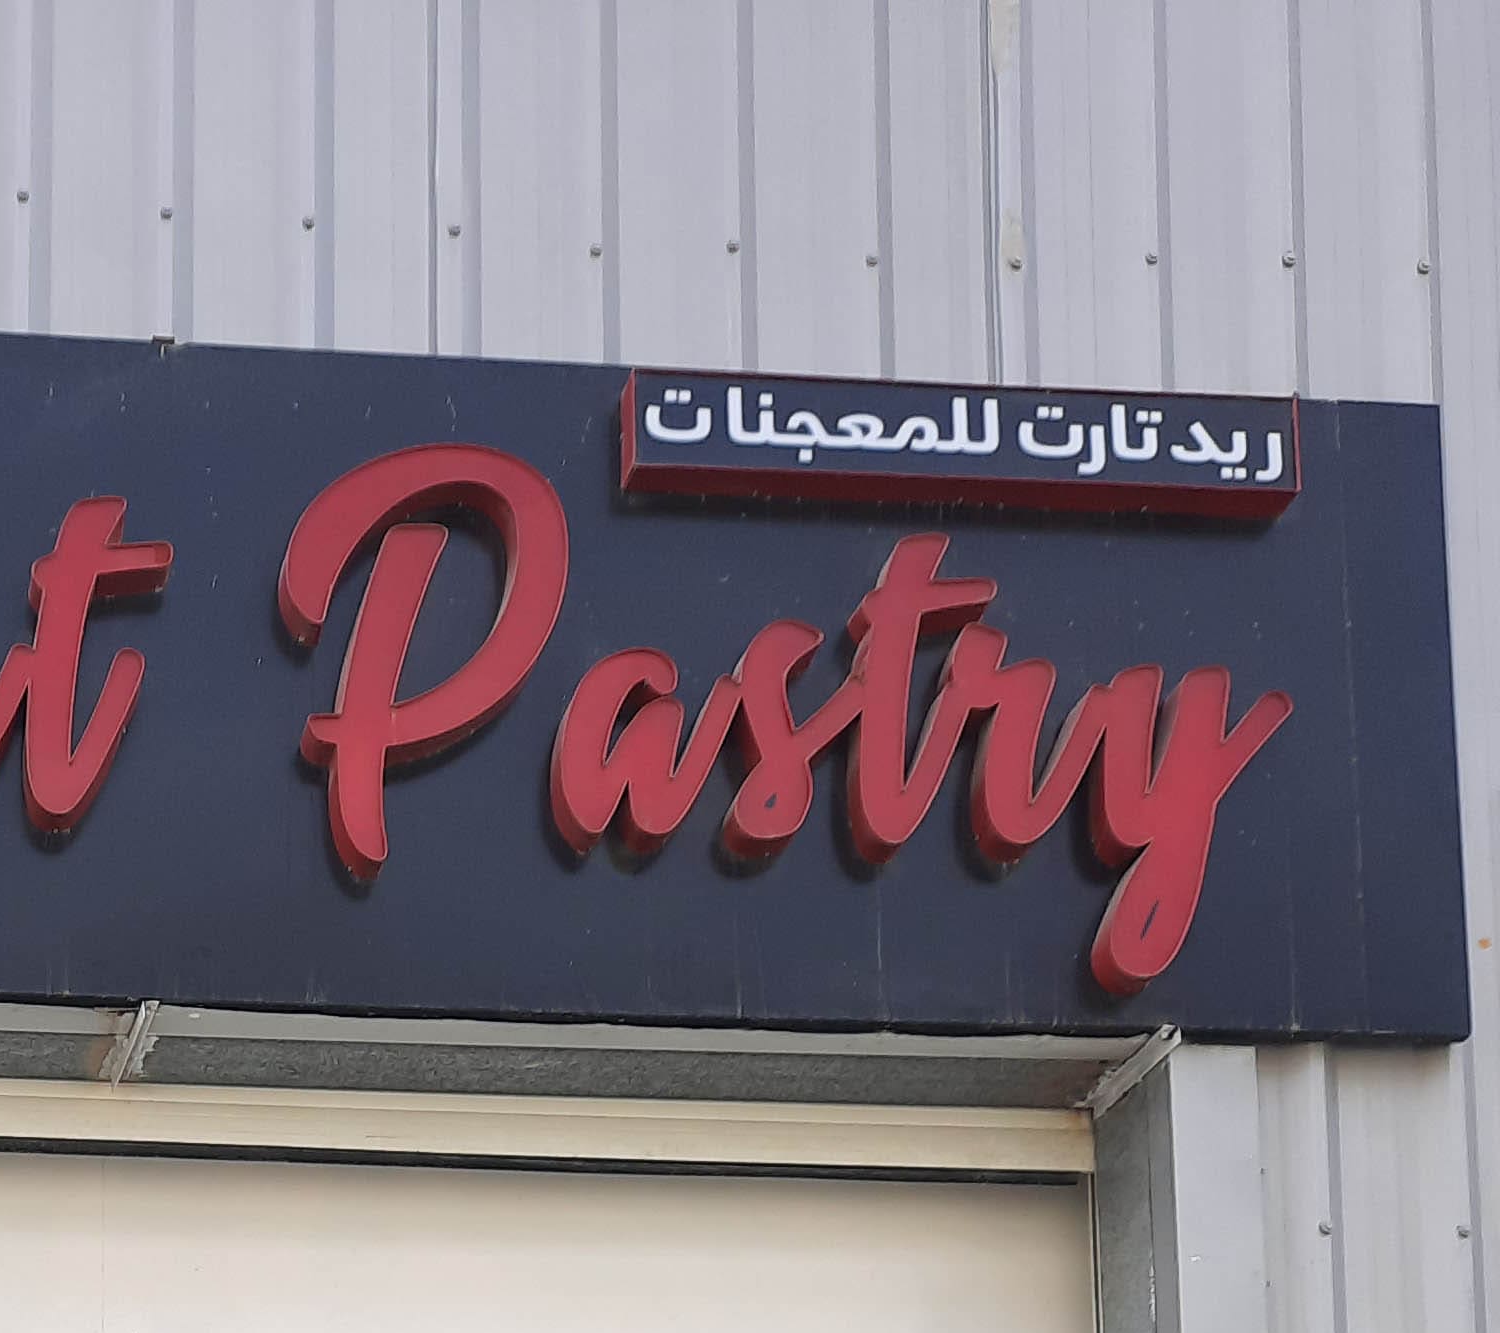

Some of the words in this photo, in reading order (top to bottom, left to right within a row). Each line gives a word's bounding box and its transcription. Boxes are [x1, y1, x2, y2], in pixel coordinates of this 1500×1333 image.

[644, 386, 1000, 464] للمعجنات
[1017, 403, 1164, 474] تارت
[1169, 420, 1285, 482] ريد
[278, 442, 1294, 996] Pastry
